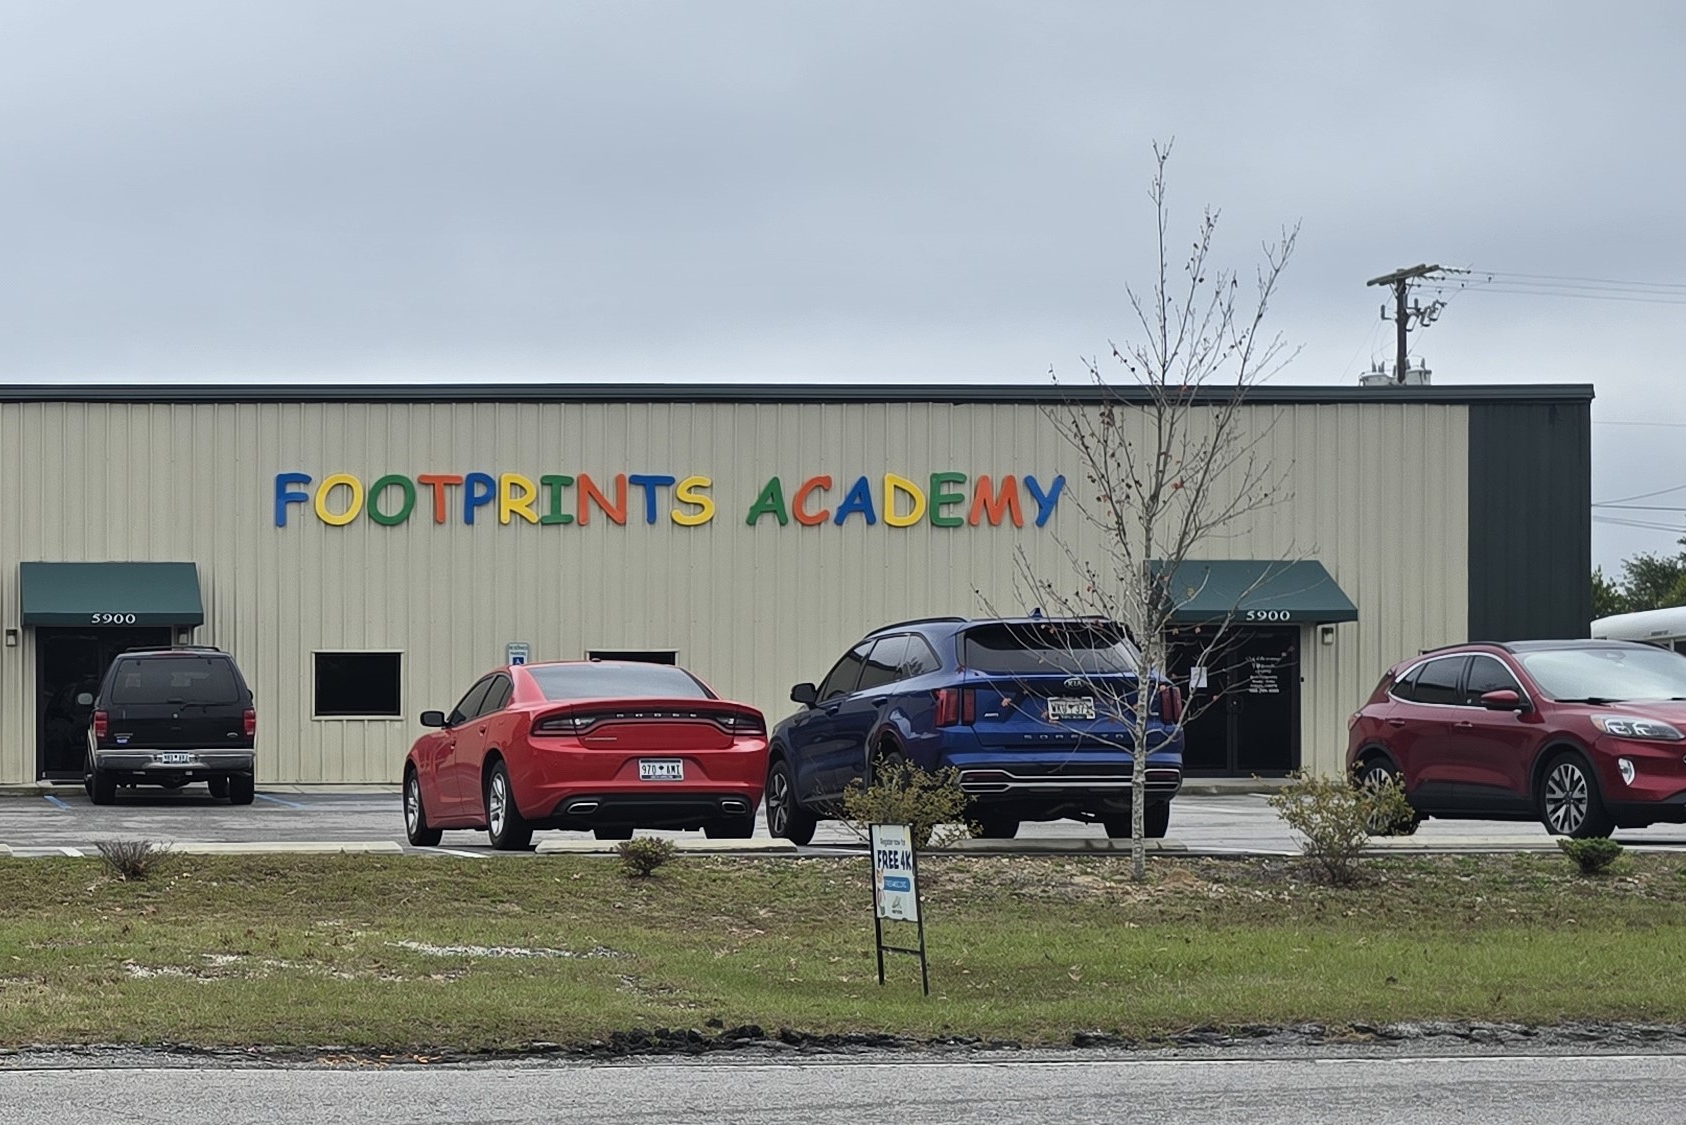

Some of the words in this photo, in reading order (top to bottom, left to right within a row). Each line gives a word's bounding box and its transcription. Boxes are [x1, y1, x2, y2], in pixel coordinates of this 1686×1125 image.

[275, 473, 715, 527] FOOTPRINTS
[745, 472, 1066, 528] ACADEMY
[91, 613, 136, 624] 5900
[1246, 610, 1290, 621] 5900
[877, 850, 899, 870] FREE
[900, 850, 912, 871] 4K
